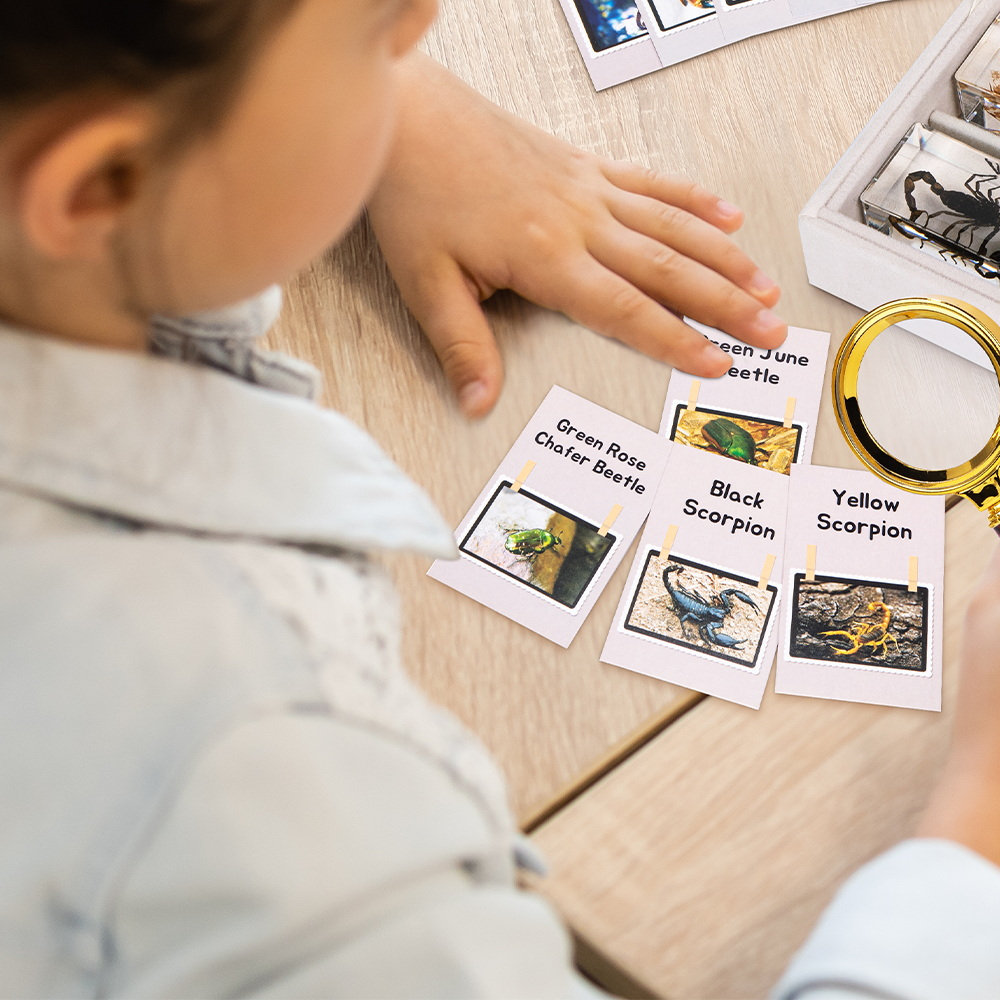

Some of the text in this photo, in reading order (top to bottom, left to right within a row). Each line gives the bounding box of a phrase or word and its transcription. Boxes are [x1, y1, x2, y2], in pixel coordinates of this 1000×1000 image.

[724, 366, 780, 384] eetle
[556, 418, 647, 471] Green Rose
[534, 431, 646, 494] Chafer Beetle
[709, 479, 764, 509] Black
[832, 489, 900, 512] Yellow
[683, 499, 776, 540] Scorpion
[817, 513, 913, 540] Scorpion
